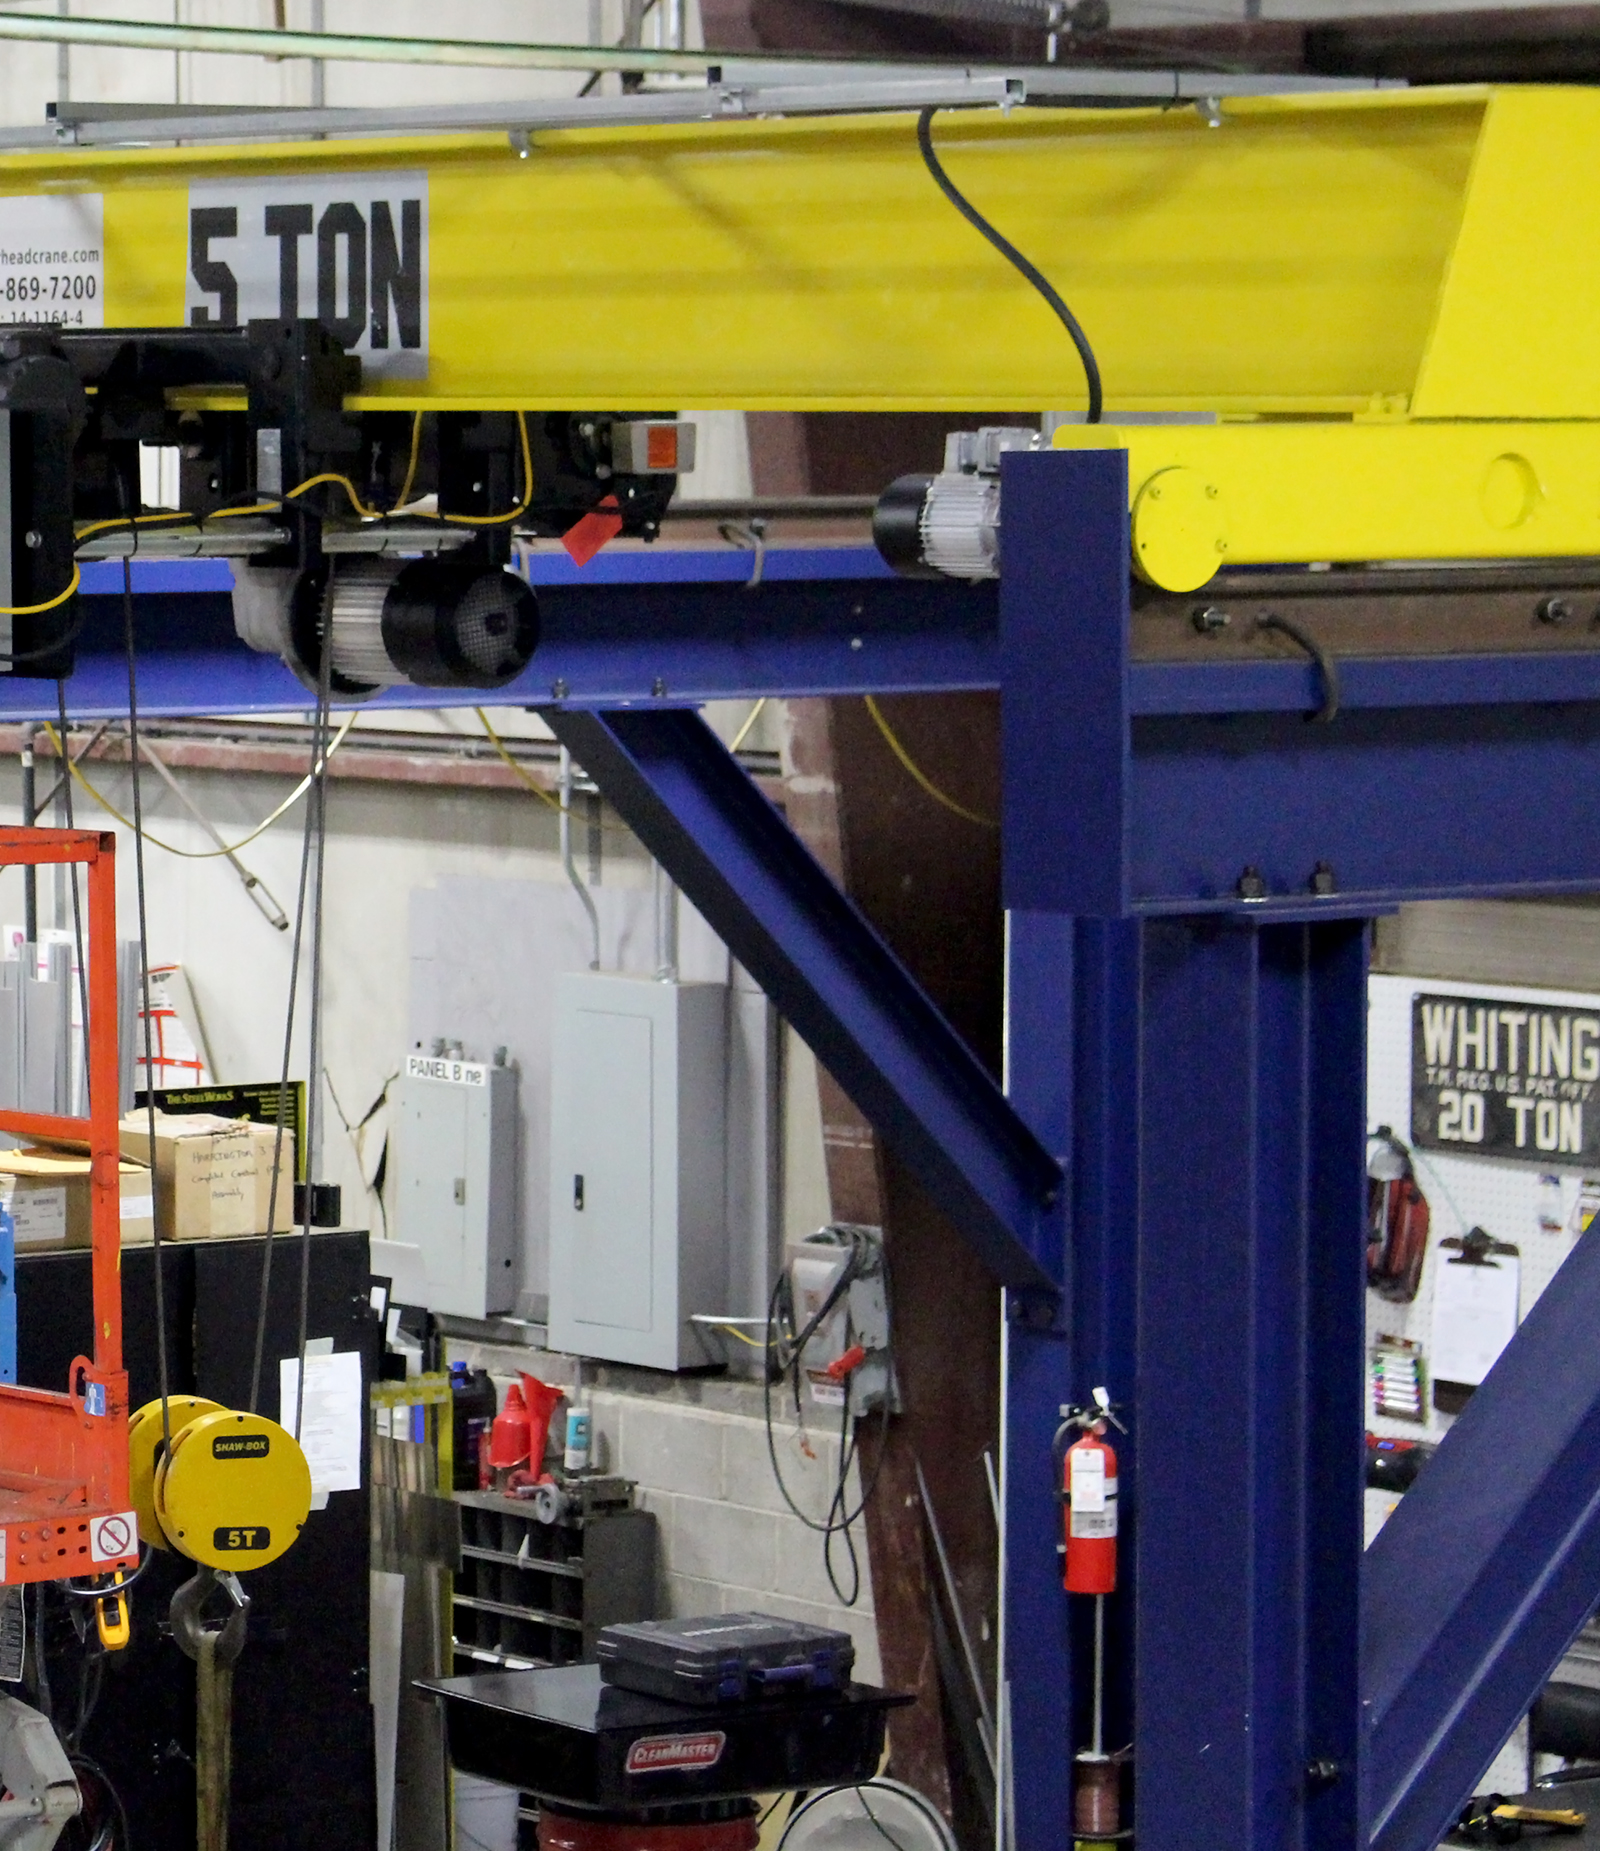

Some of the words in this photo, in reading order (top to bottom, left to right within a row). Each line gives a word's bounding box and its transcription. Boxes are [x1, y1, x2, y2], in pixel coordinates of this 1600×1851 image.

[190, 206, 238, 327] 5
[265, 199, 422, 350] TON
[1421, 1003, 1600, 1082] WHITING
[410, 1058, 449, 1080] PANEL
[453, 1064, 462, 1081] B
[1437, 1089, 1485, 1144] 20
[1506, 1095, 1583, 1155] TON
[215, 1441, 266, 1453] SHAW-BOX
[227, 1530, 257, 1548] 5T
